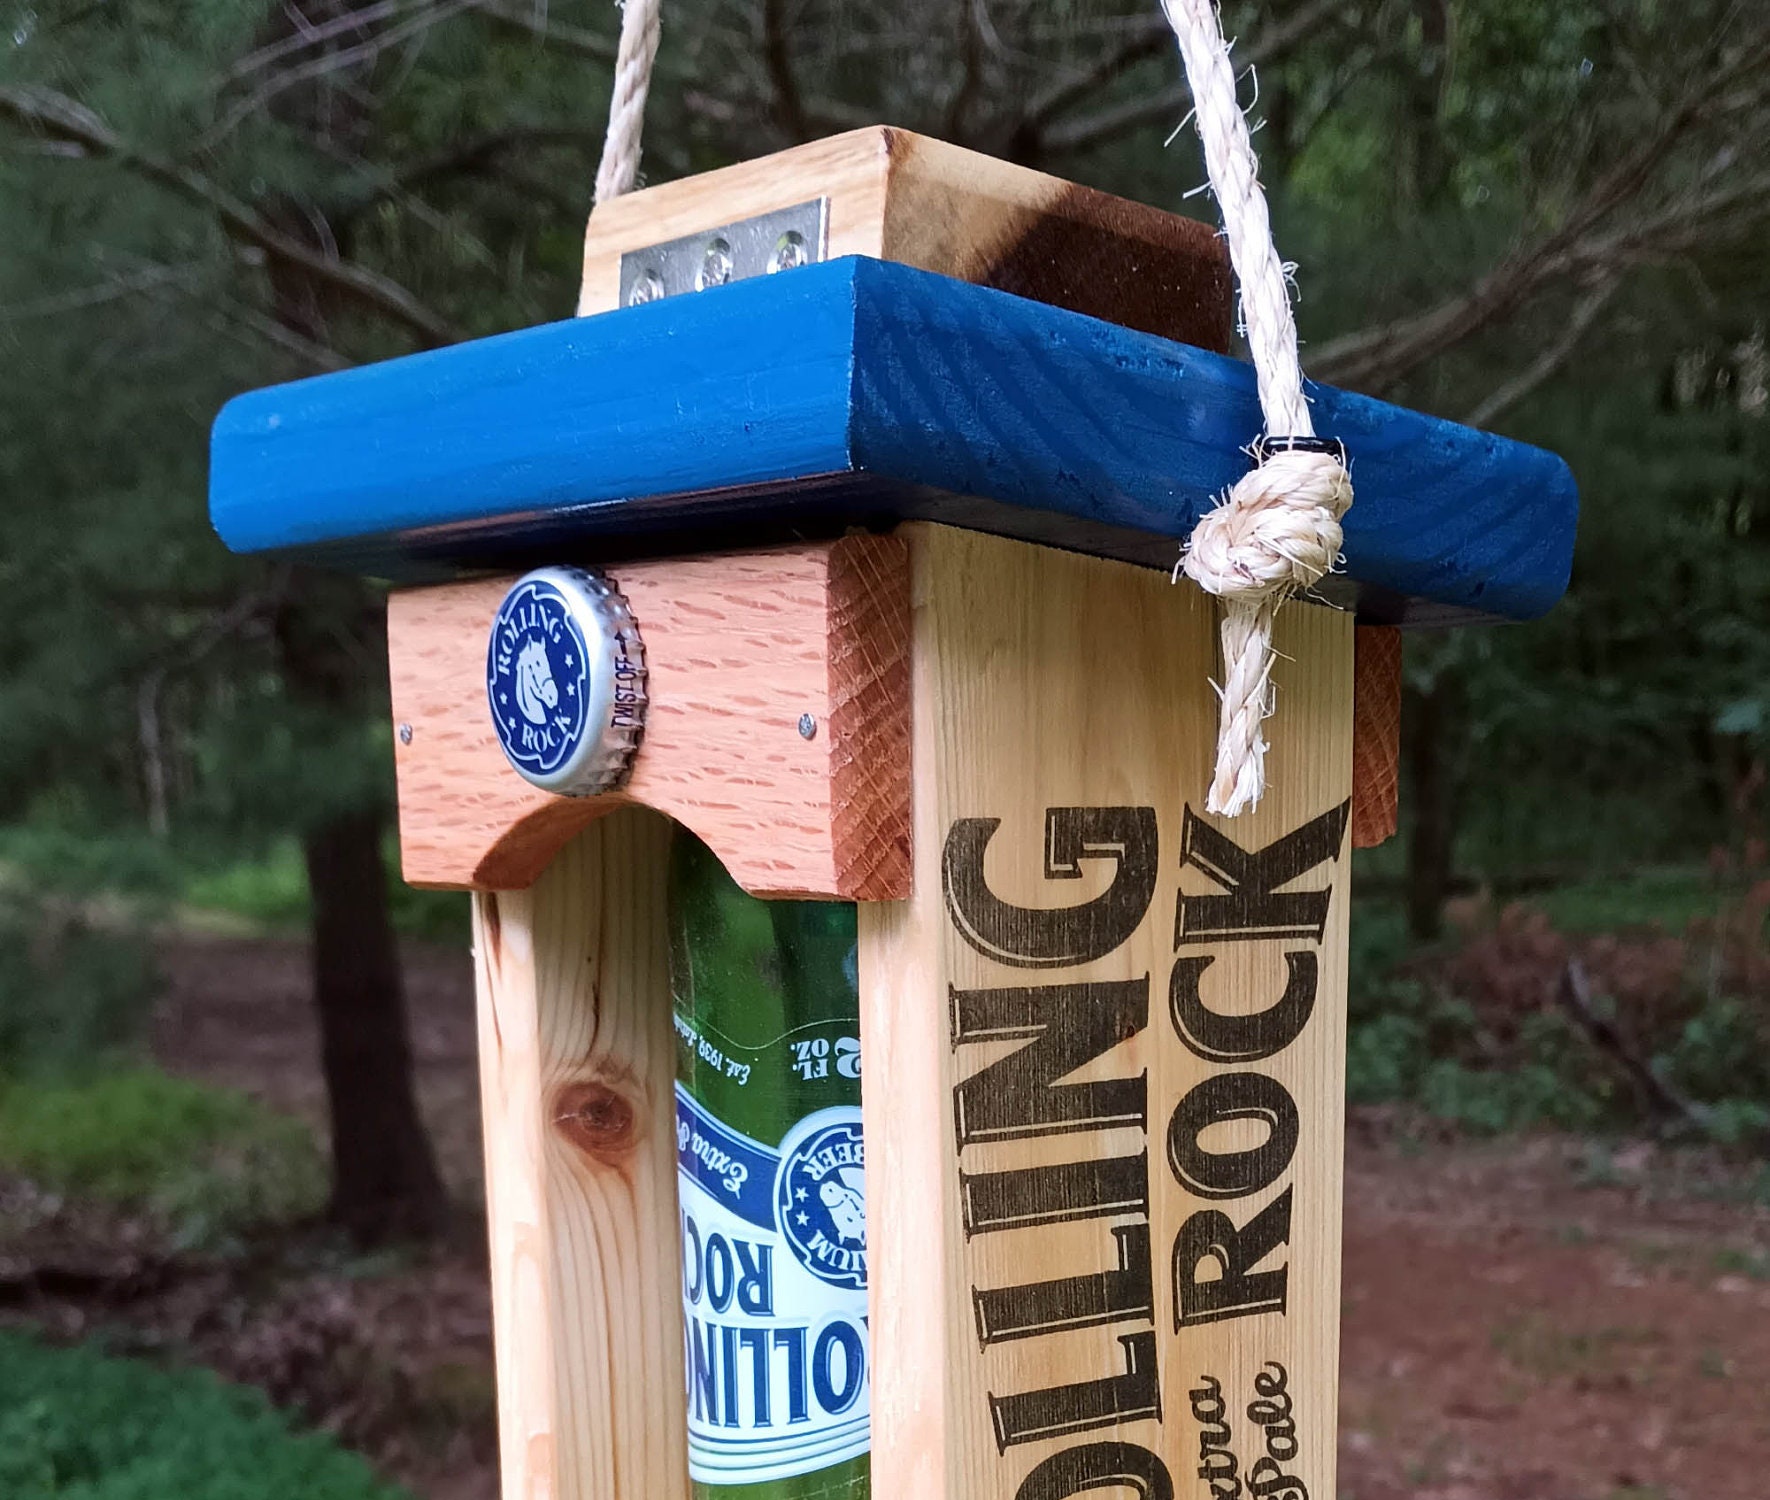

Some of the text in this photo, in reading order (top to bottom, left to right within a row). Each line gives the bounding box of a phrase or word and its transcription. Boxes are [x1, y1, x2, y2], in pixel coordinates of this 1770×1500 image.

[498, 603, 564, 676] ROLLING
[611, 656, 637, 728] TWIST OFF
[521, 709, 573, 754] ROCK
[1167, 795, 1352, 1336] ROCK
[691, 1132, 749, 1200] Extra
[682, 1209, 775, 1317] ROC
[685, 1314, 870, 1429] OLLIN
